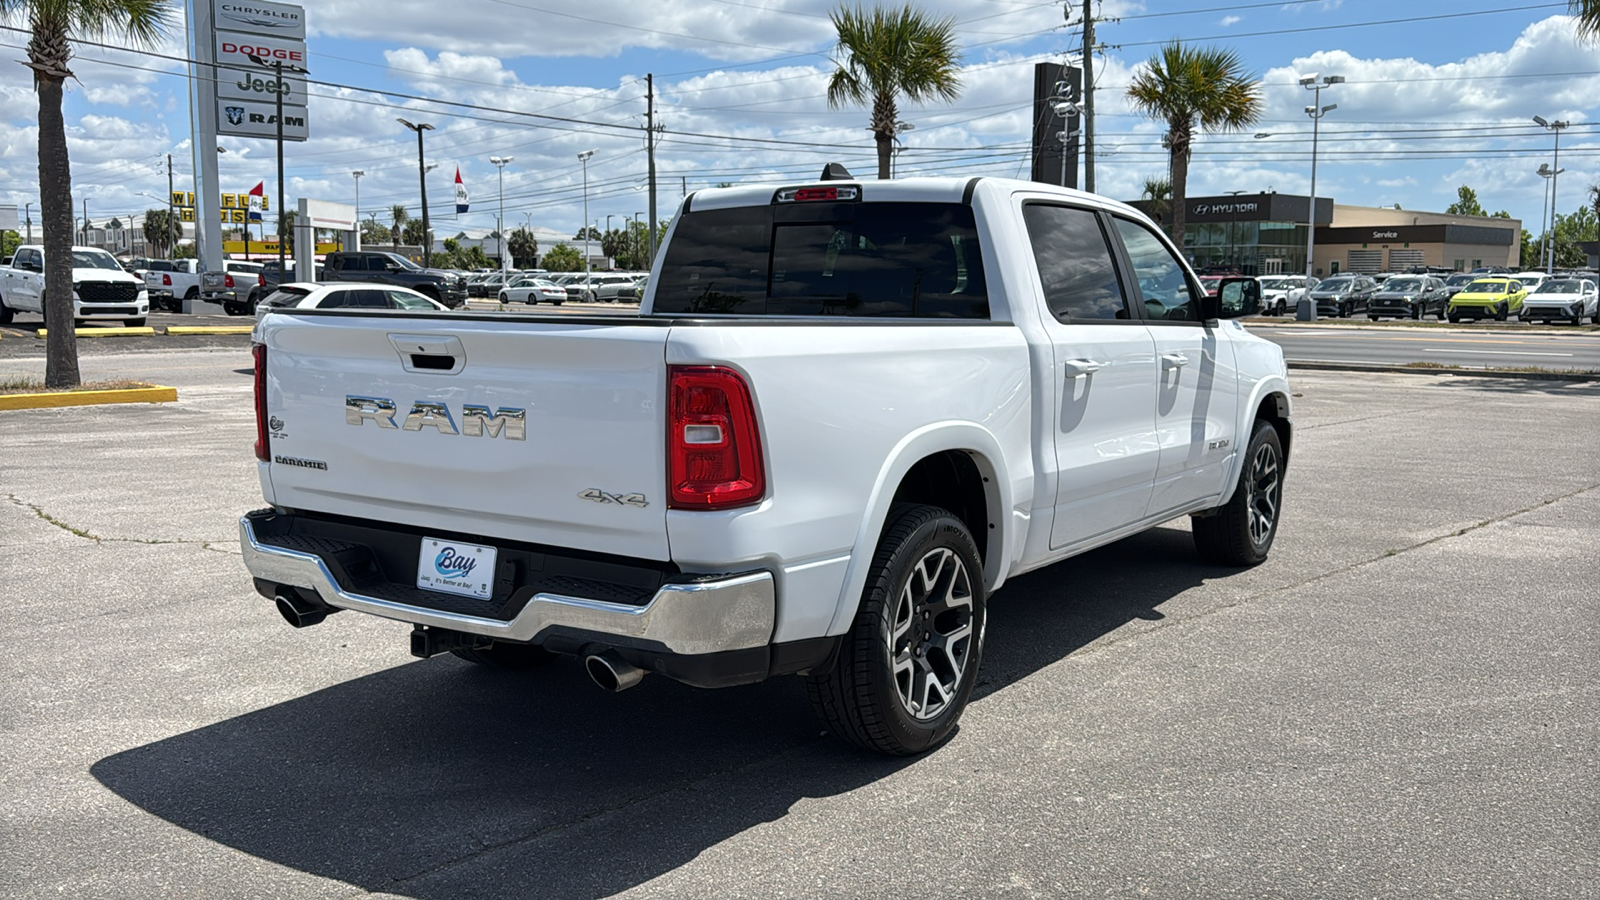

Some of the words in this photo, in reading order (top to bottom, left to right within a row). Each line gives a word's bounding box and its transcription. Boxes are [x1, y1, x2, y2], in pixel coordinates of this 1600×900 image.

[221, 4, 299, 20] CHRYSLER
[222, 42, 302, 61] DODGE
[237, 73, 291, 96] Jeep
[249, 113, 304, 127] RAM
[1372, 231, 1398, 239] Service
[346, 395, 526, 441] RAM
[275, 455, 328, 471] LARAMIE
[437, 547, 477, 577] Bay
[443, 578, 457, 586] Better
